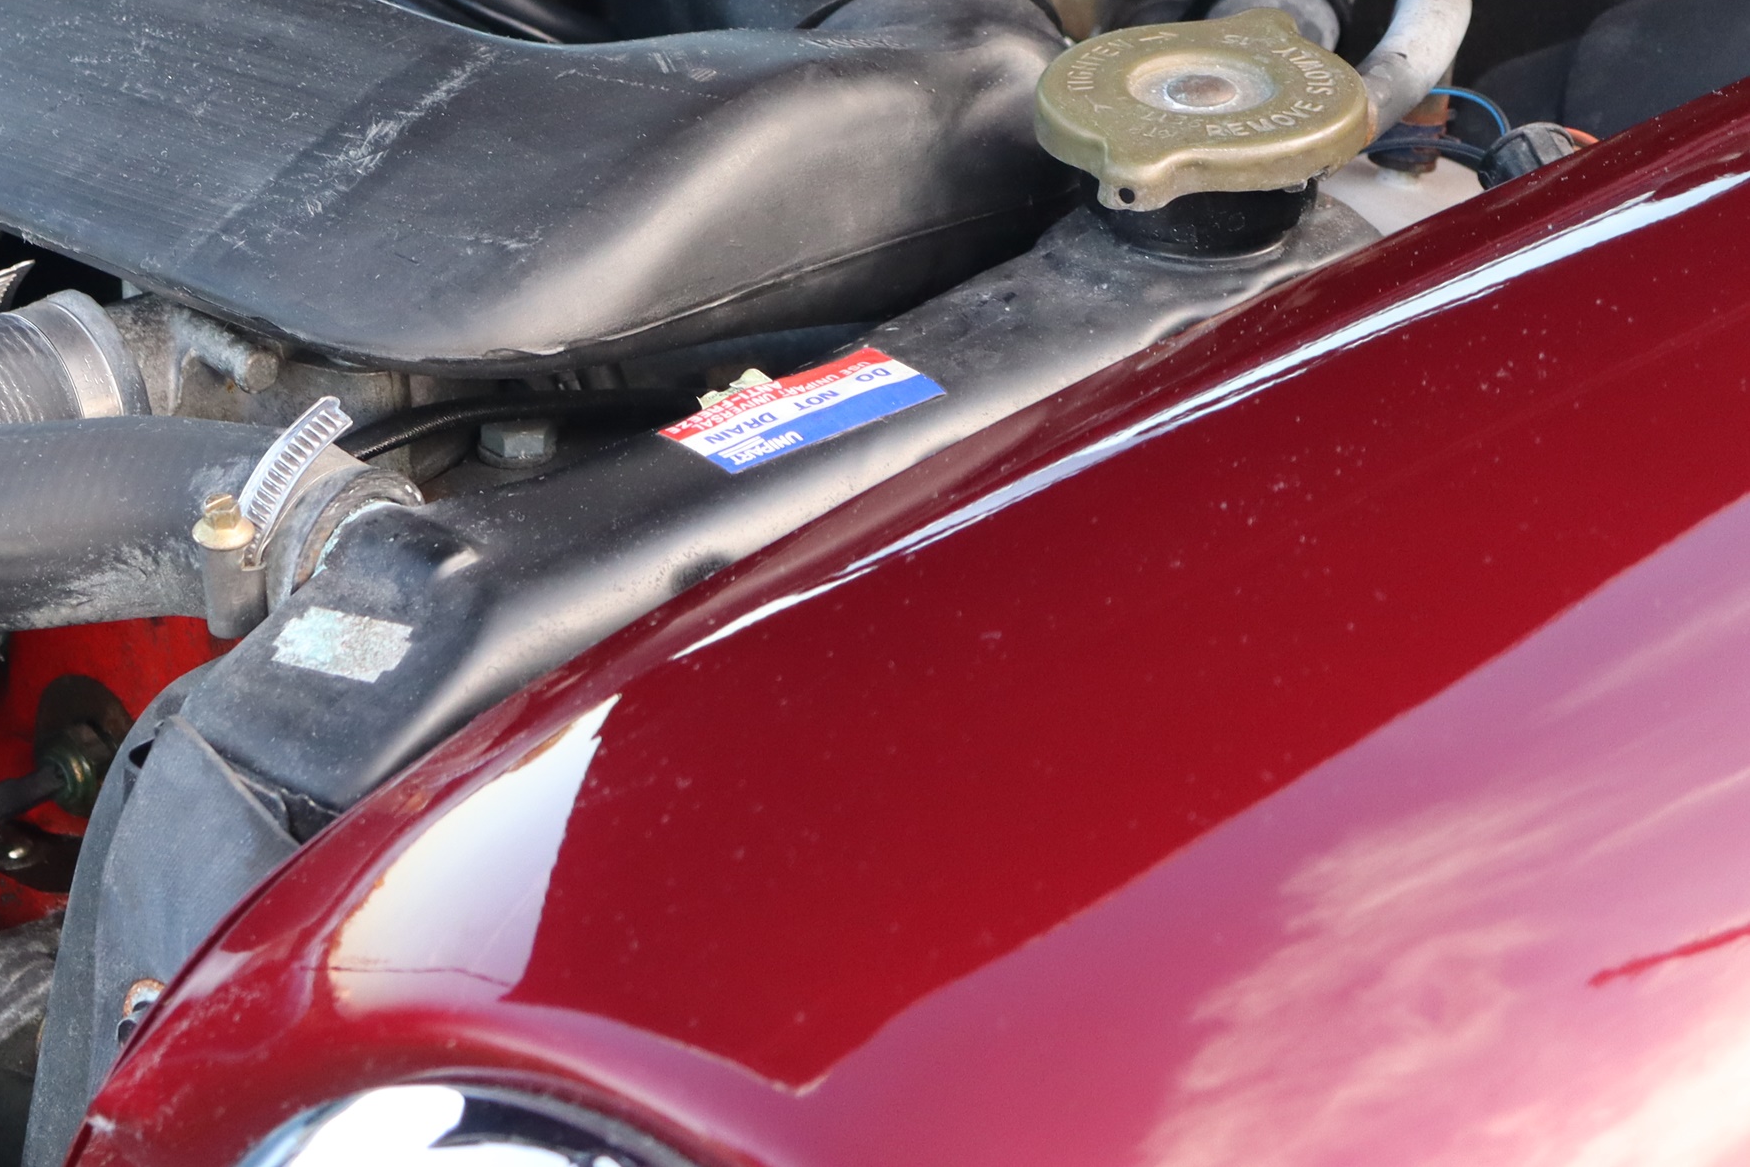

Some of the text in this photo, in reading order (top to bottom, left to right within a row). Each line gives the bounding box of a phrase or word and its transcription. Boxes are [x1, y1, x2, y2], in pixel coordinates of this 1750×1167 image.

[1066, 38, 1135, 91] TIGHTEN
[1204, 46, 1337, 138] REMOVE SLOWLY
[780, 373, 840, 397] UNIPART
[838, 361, 872, 376] USE
[664, 380, 784, 434] ANTI-FREEZE
[691, 392, 778, 432] UNIVERSAL
[704, 367, 892, 445] DO NOT DRAIN
[730, 430, 804, 466] UNIPART
